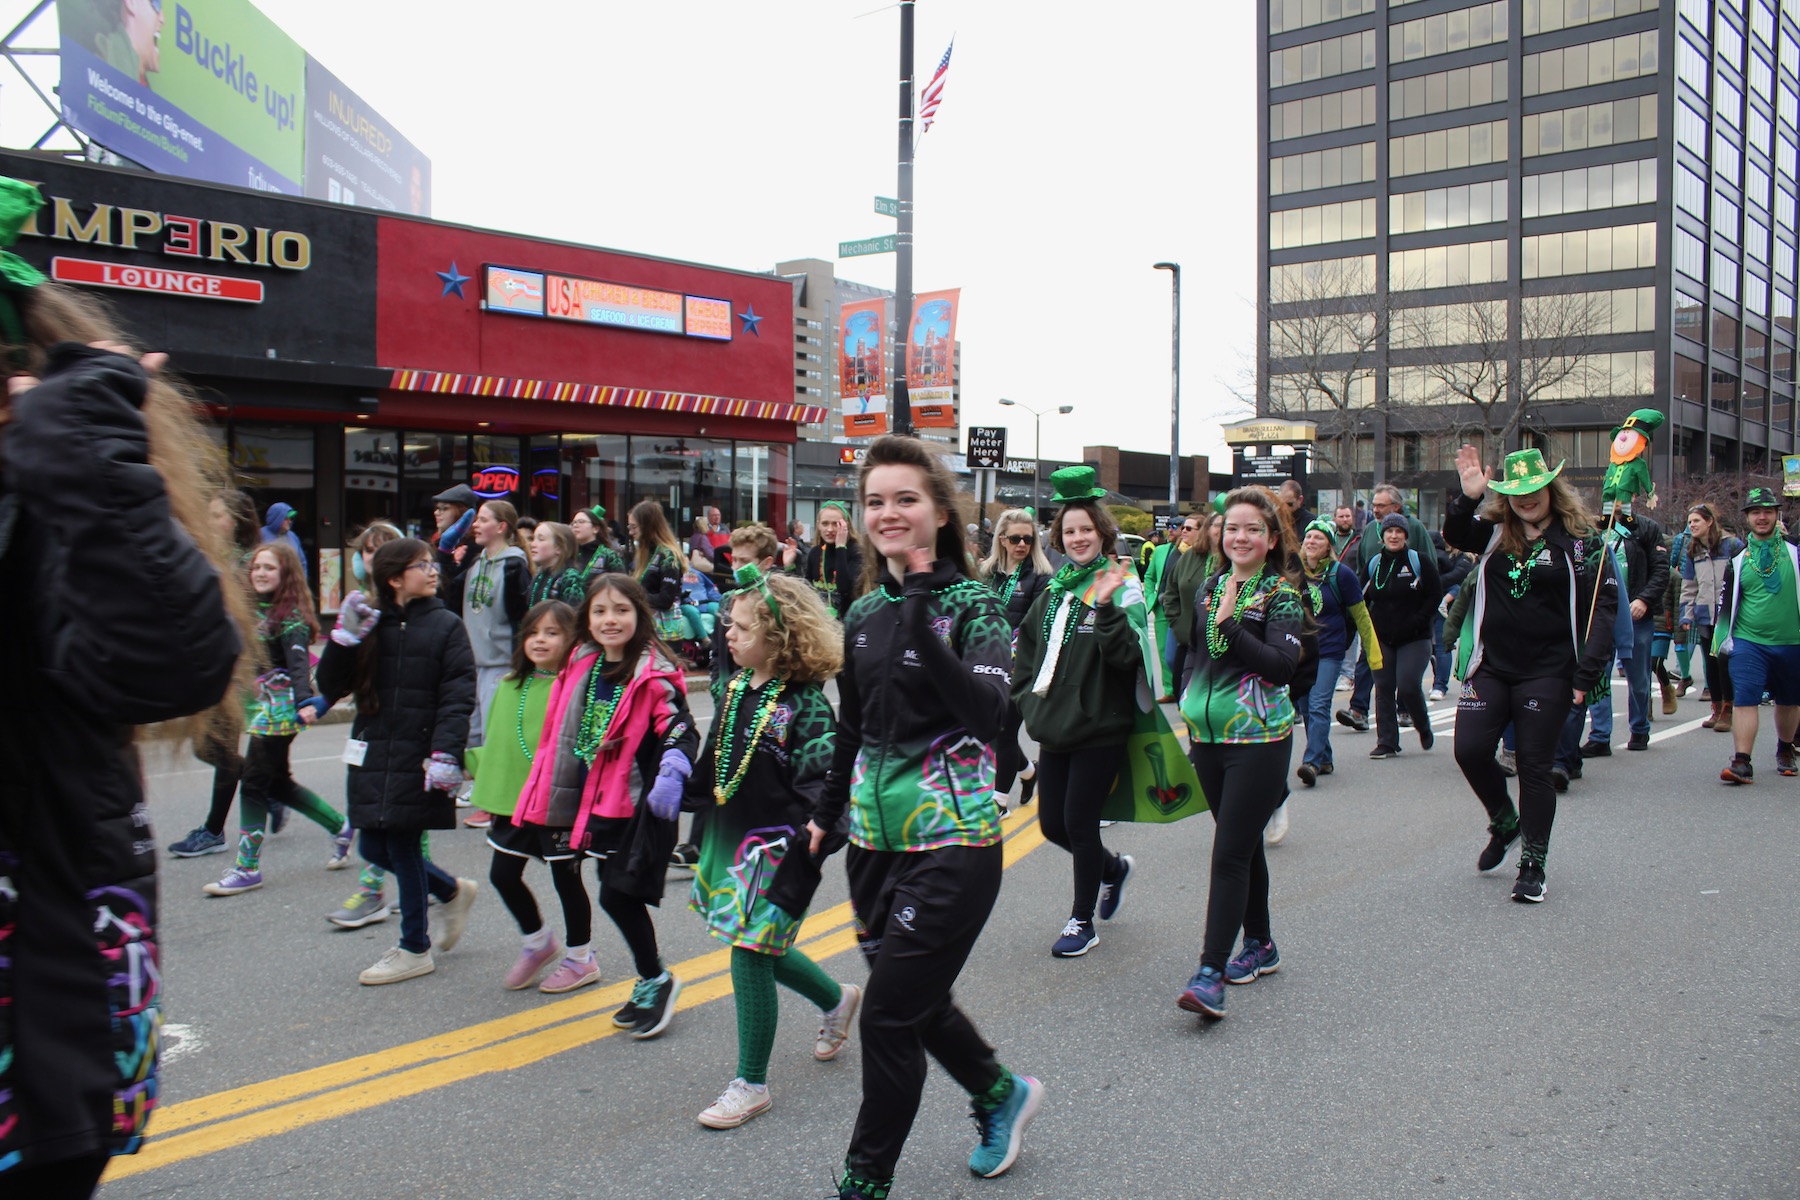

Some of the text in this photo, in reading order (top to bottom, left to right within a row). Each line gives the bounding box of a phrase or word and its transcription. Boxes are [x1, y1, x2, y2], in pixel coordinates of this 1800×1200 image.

[175, 2, 295, 132] Buckle up!
[87, 66, 134, 110] Welcome
[135, 97, 147, 116] to
[147, 104, 162, 125] the
[329, 90, 393, 158] INJURED?
[875, 198, 897, 215] Elm St
[841, 238, 894, 255] Mechanic St
[102, 265, 222, 296] LOUNGE
[547, 274, 584, 320] USA
[582, 280, 629, 306] CHICKEN
[631, 287, 640, 305] &
[590, 308, 676, 330] SEAFOOD & ICE CREAM
[687, 300, 728, 321] KABOB
[970, 437, 1002, 447] Meter
[976, 428, 997, 438] Pay
[973, 447, 999, 456] Here
[1007, 460, 1023, 473] A&E
[1023, 461, 1037, 470] COFFE
[472, 472, 520, 492] OPEN
